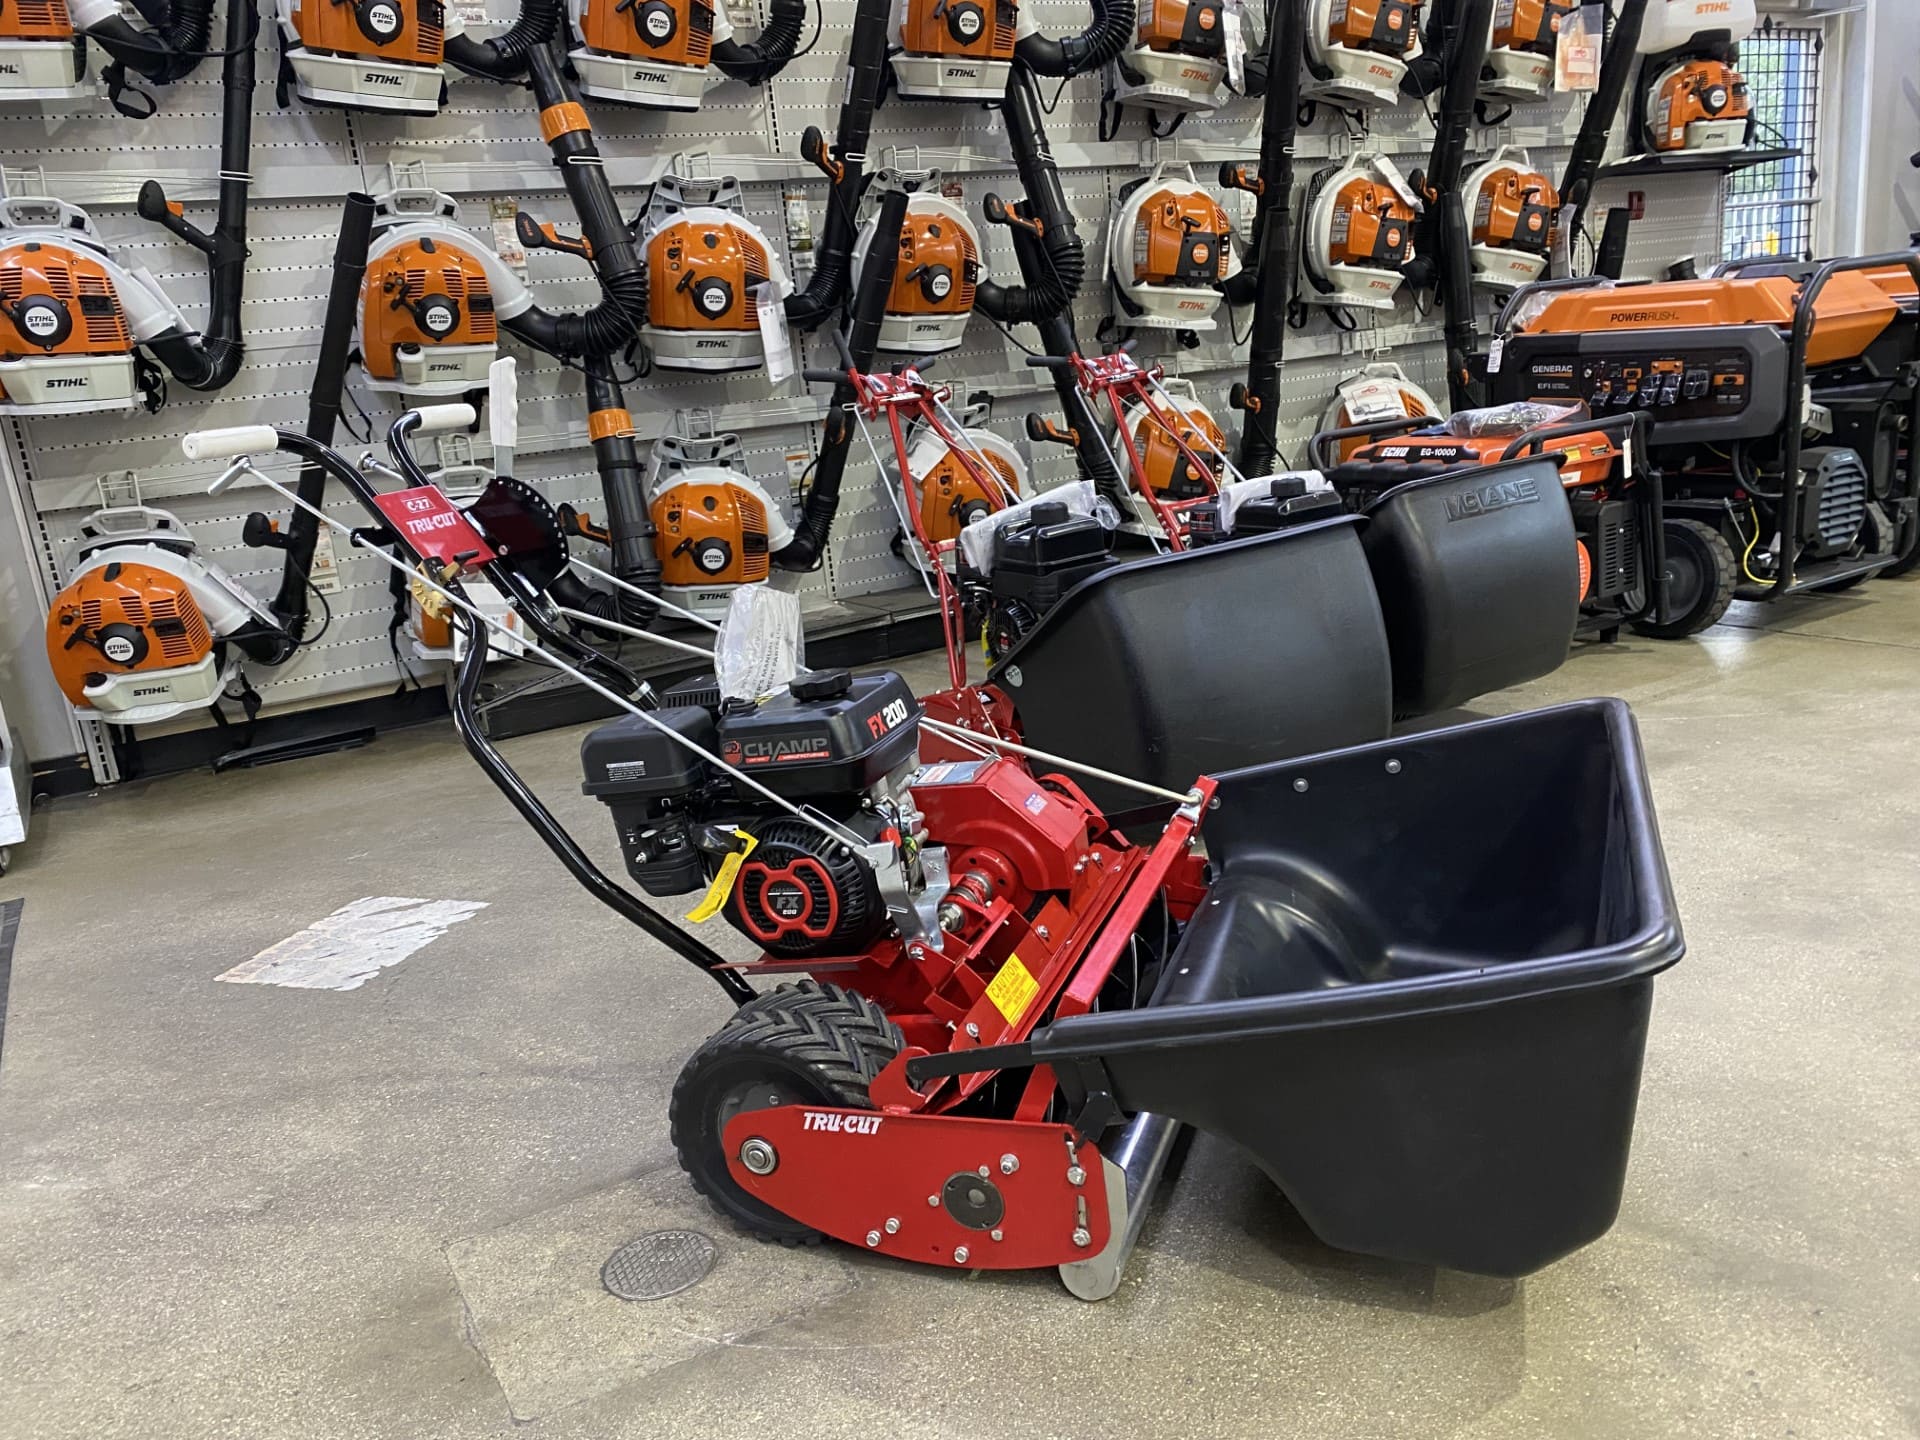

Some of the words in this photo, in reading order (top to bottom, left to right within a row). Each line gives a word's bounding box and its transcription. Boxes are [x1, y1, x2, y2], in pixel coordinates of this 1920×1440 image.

[1695, 2, 1730, 14] STIHL
[371, 12, 395, 21] STIHL
[633, 71, 668, 83] STIHL
[947, 68, 977, 78] STIHL
[1180, 68, 1210, 82] STIHL
[1368, 65, 1393, 78] STIHL
[363, 73, 402, 86] STIHL
[1508, 262, 1533, 273] STIHL
[1177, 301, 1206, 310] STIHL
[27, 315, 55, 323] STIHL
[696, 340, 728, 348] STIHL
[428, 364, 461, 372] STIHL
[1532, 365, 1573, 373] GENERAC
[46, 378, 88, 388] STIHL
[1380, 447, 1409, 457] ECHO
[1419, 448, 1456, 456] EG-10000
[406, 498, 431, 512] C-27
[697, 593, 730, 601] STIHL
[133, 686, 169, 697] STIHL
[867, 711, 888, 739] FX
[882, 698, 908, 728] 200
[744, 738, 828, 762] CHAMP
[776, 896, 799, 909] FX
[991, 962, 1019, 998] CAUTION
[803, 1112, 883, 1135] TRU-CUT
